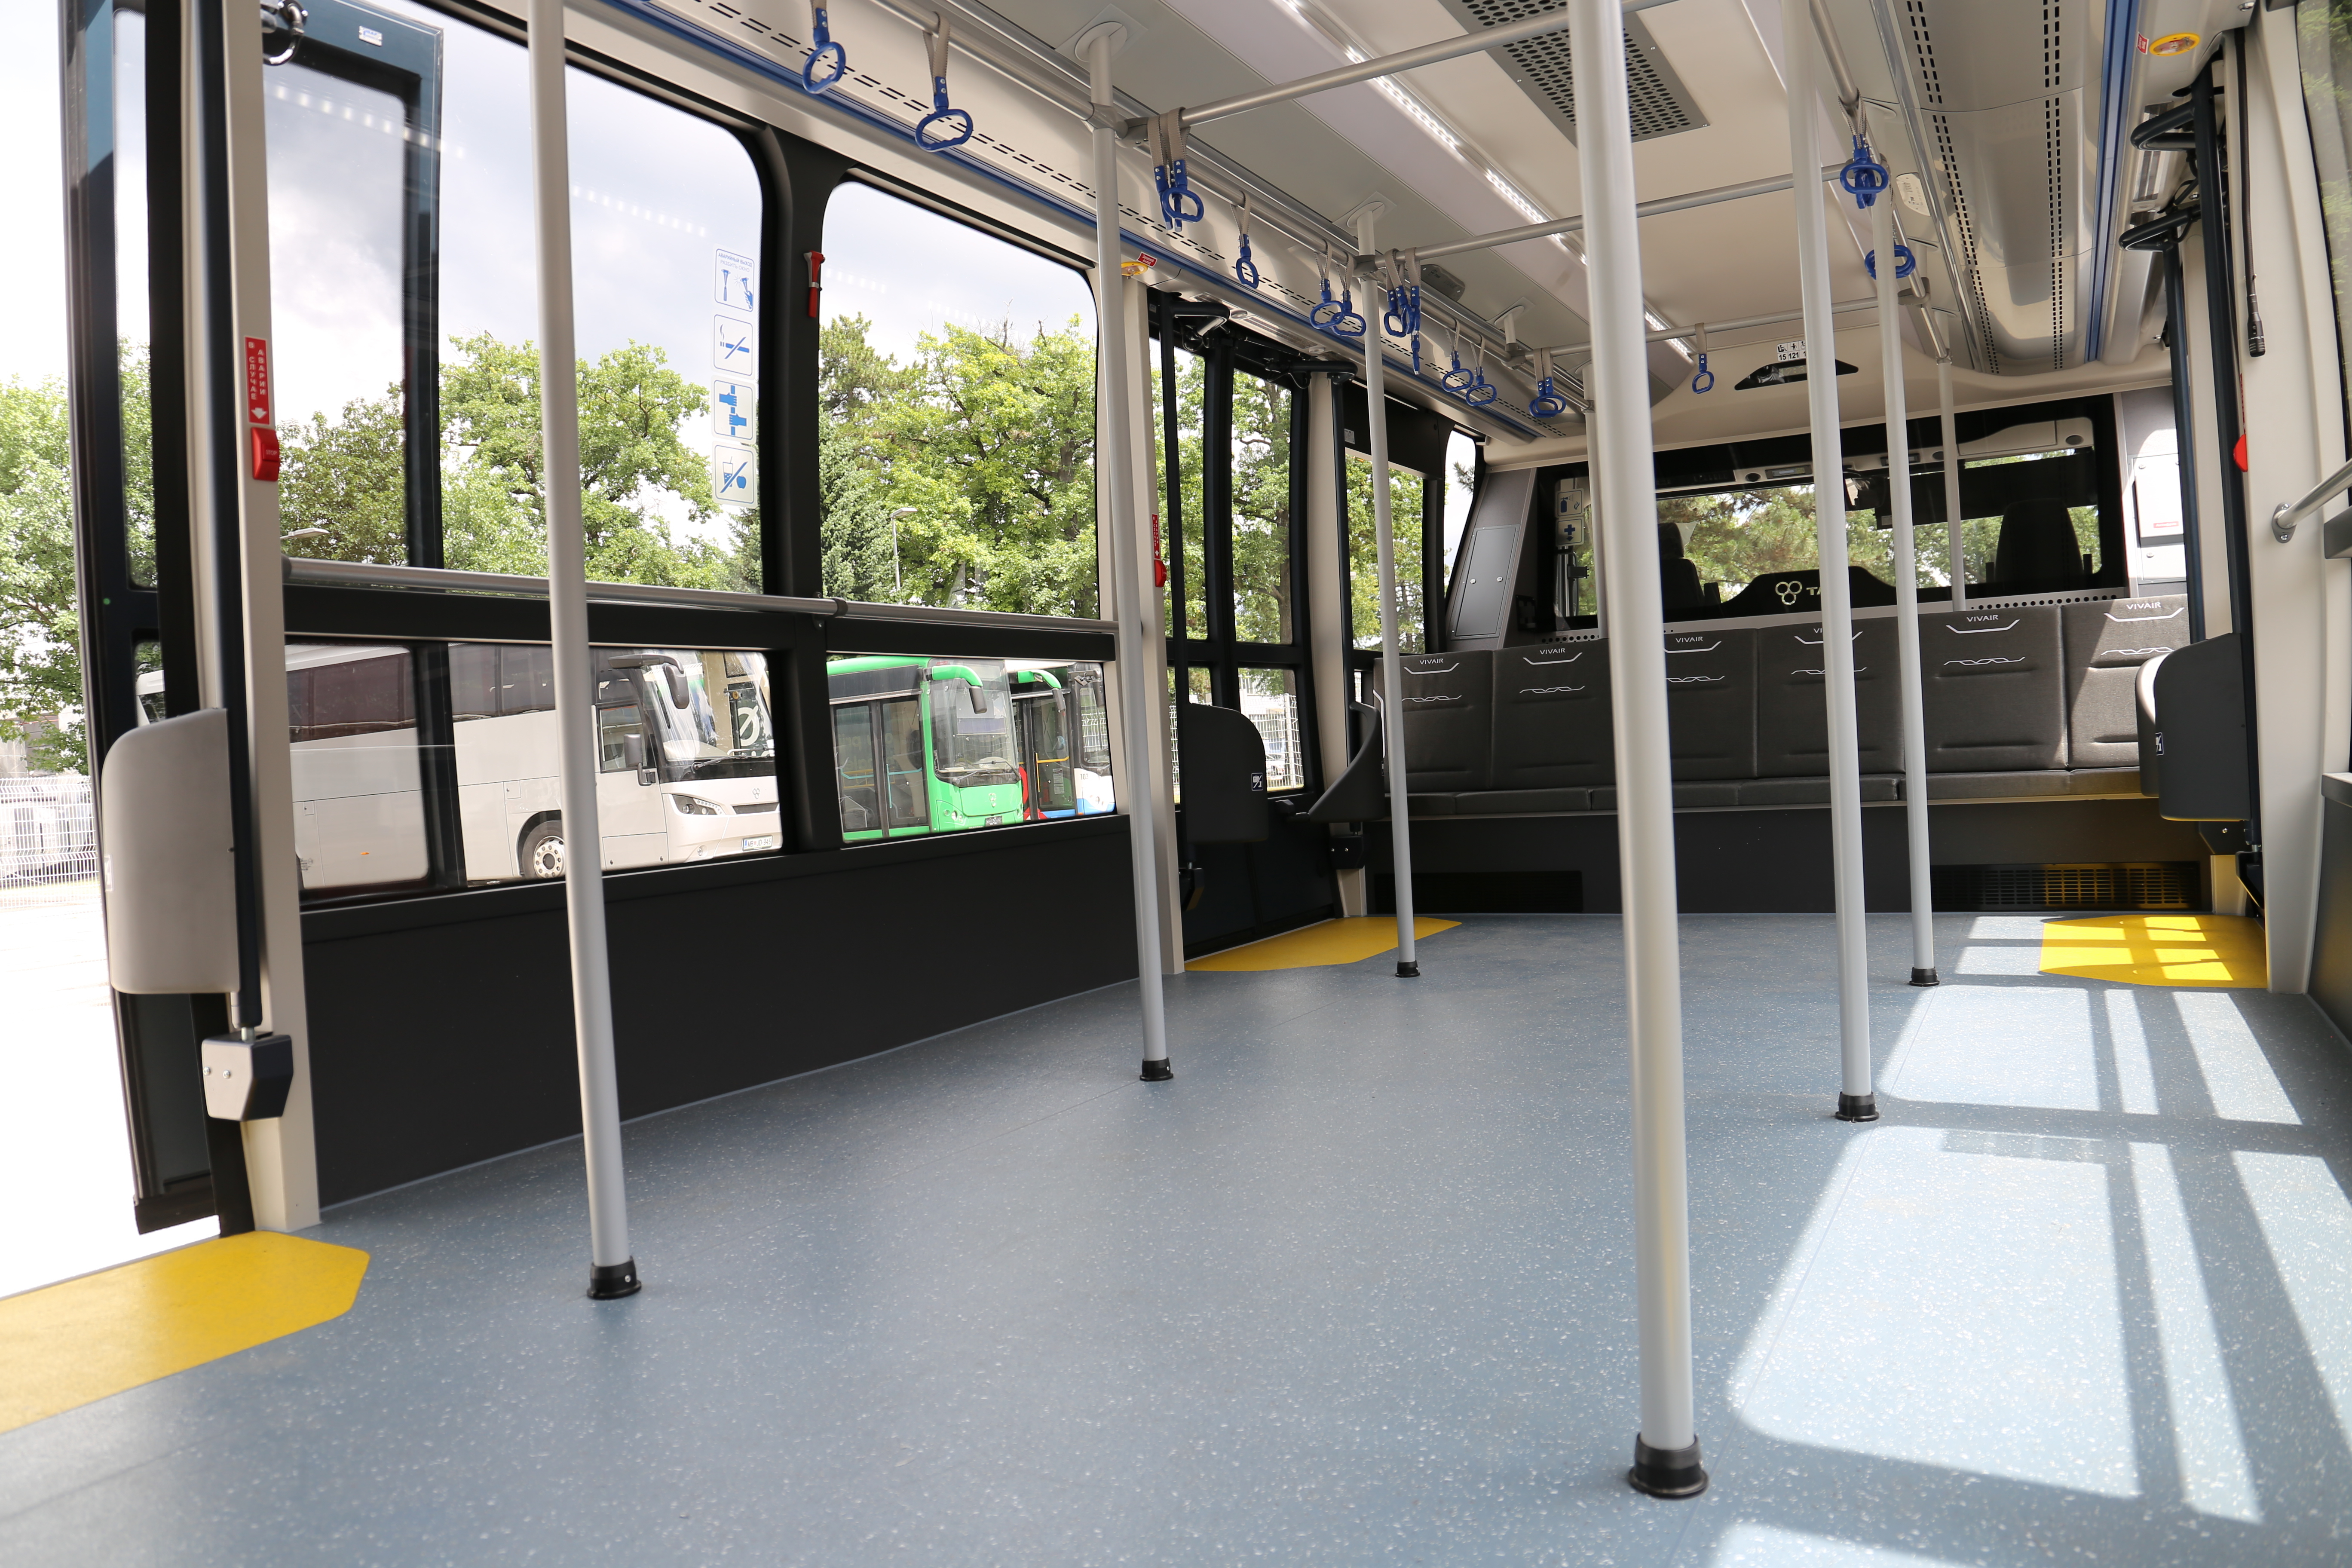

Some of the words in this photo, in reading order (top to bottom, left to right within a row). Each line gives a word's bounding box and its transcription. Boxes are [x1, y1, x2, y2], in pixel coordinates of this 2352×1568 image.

[720, 260, 738, 269] РАЗБИТЬ
[740, 259, 752, 267] ВЫХОД
[257, 349, 266, 395] АВАРИИ
[248, 356, 257, 400] СЛУЧАЕ
[2126, 602, 2162, 610] VIVAIR
[1966, 614, 1999, 622] VIVAIR
